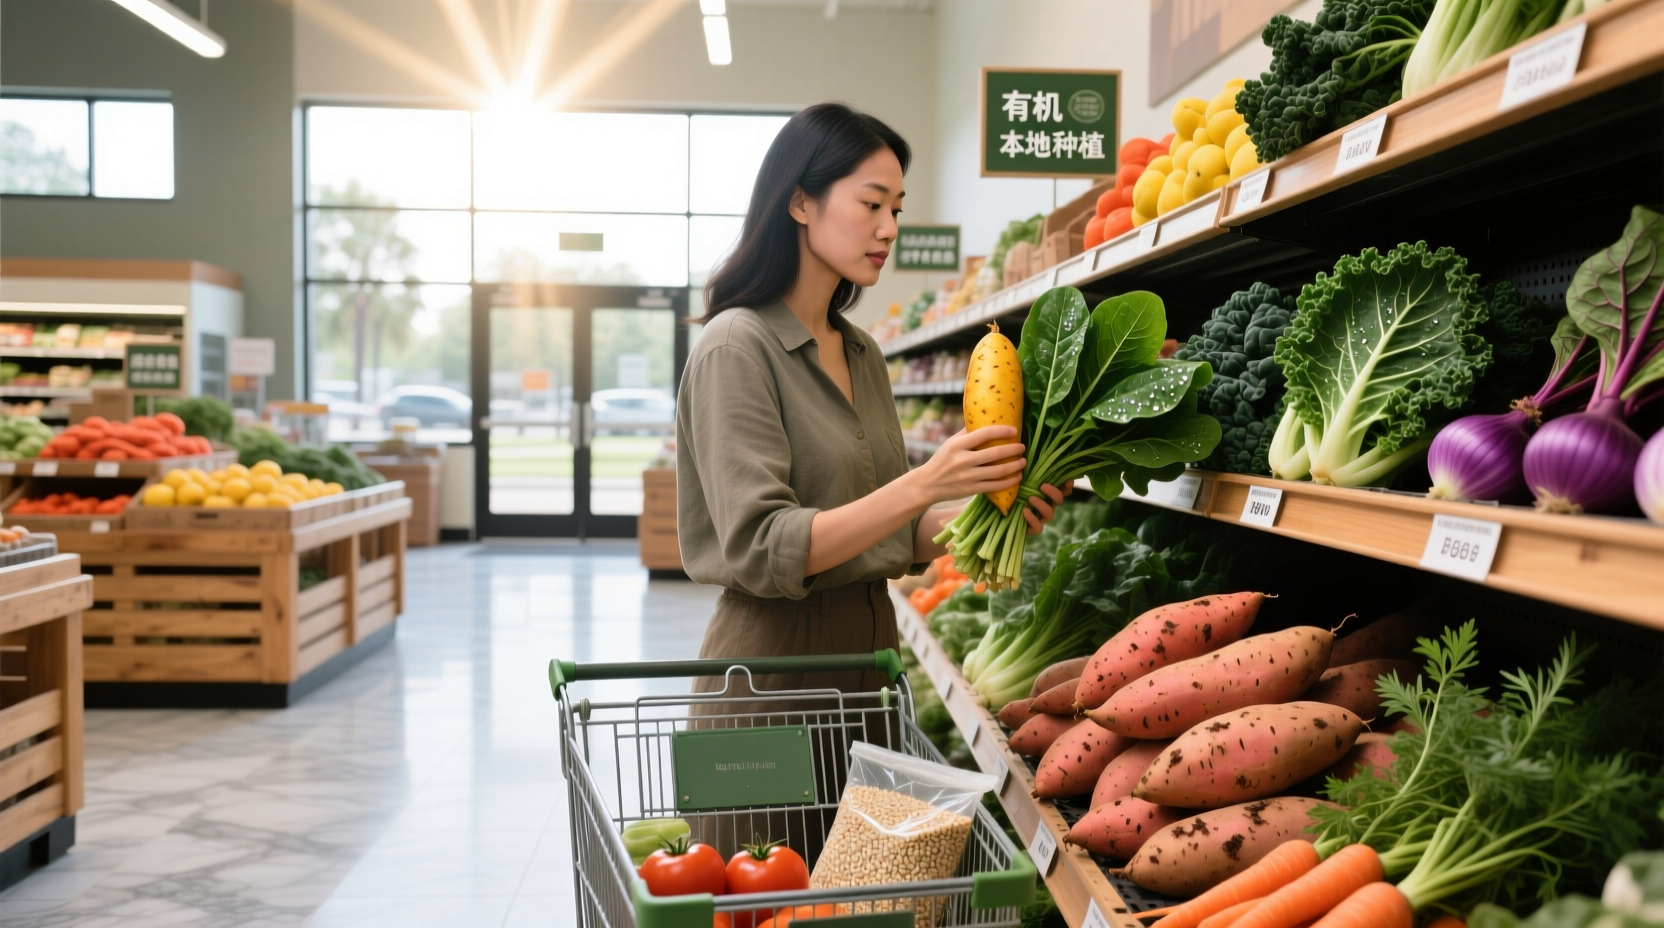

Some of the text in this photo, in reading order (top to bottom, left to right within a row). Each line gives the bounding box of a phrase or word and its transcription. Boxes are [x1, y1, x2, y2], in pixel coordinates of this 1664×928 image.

[1002, 89, 1063, 122] 有机
[999, 129, 1105, 159] 本地种植
